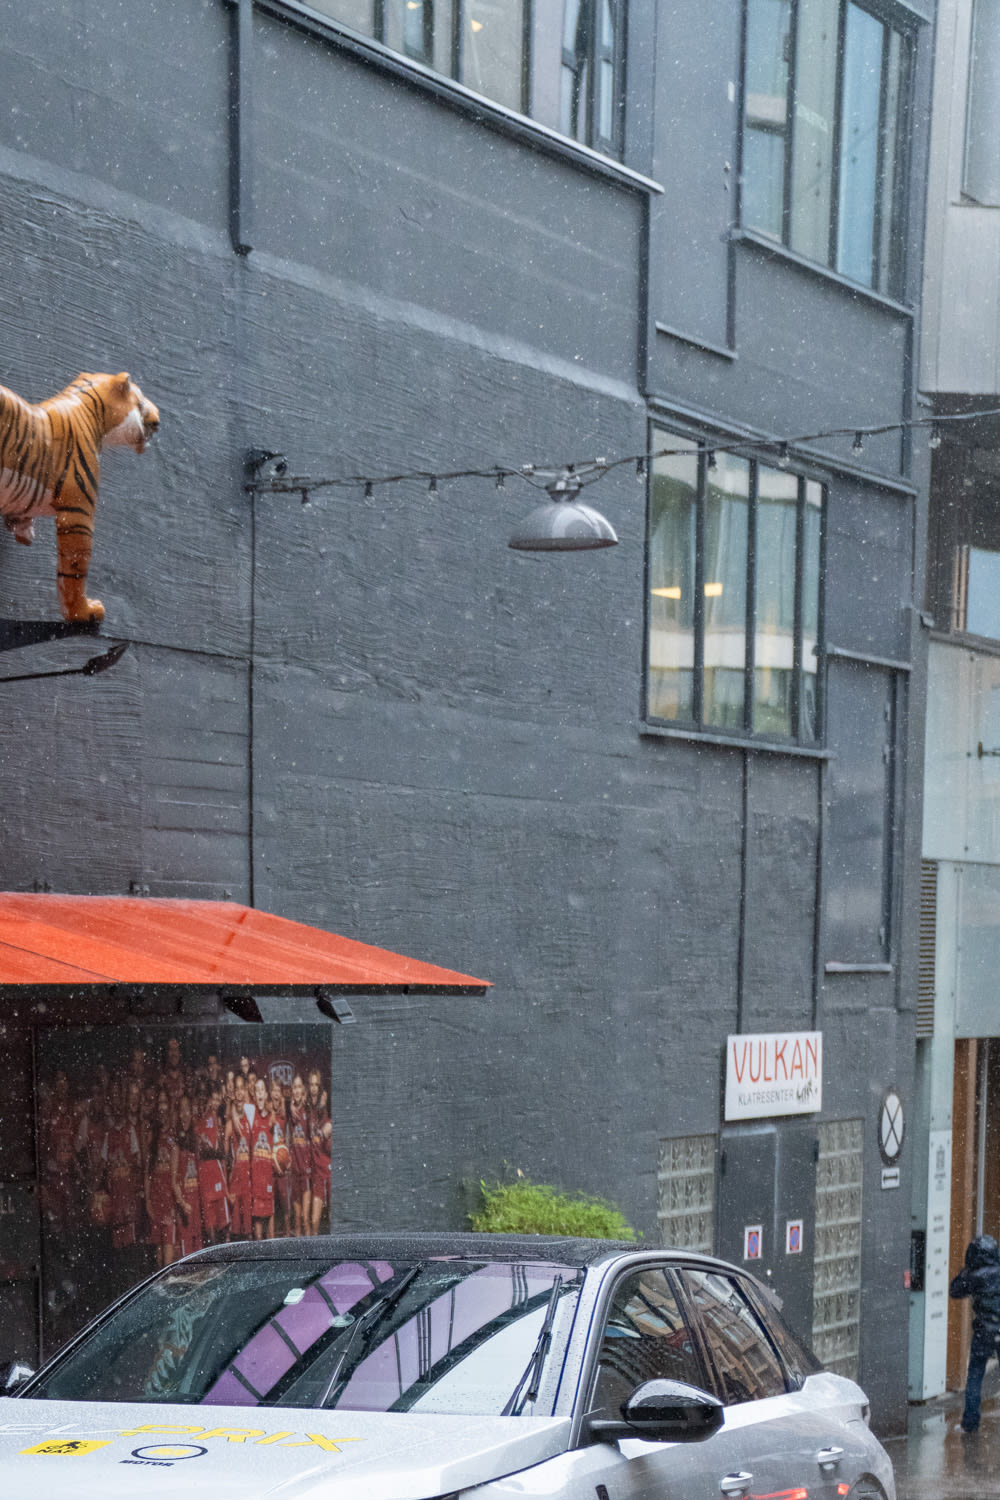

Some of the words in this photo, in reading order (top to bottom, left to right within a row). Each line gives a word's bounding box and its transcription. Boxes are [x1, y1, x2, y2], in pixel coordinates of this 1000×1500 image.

[732, 1038, 818, 1084] VULKAN
[738, 1088, 794, 1105] KLATRESENTER
[119, 1459, 175, 1468] MOTOR
